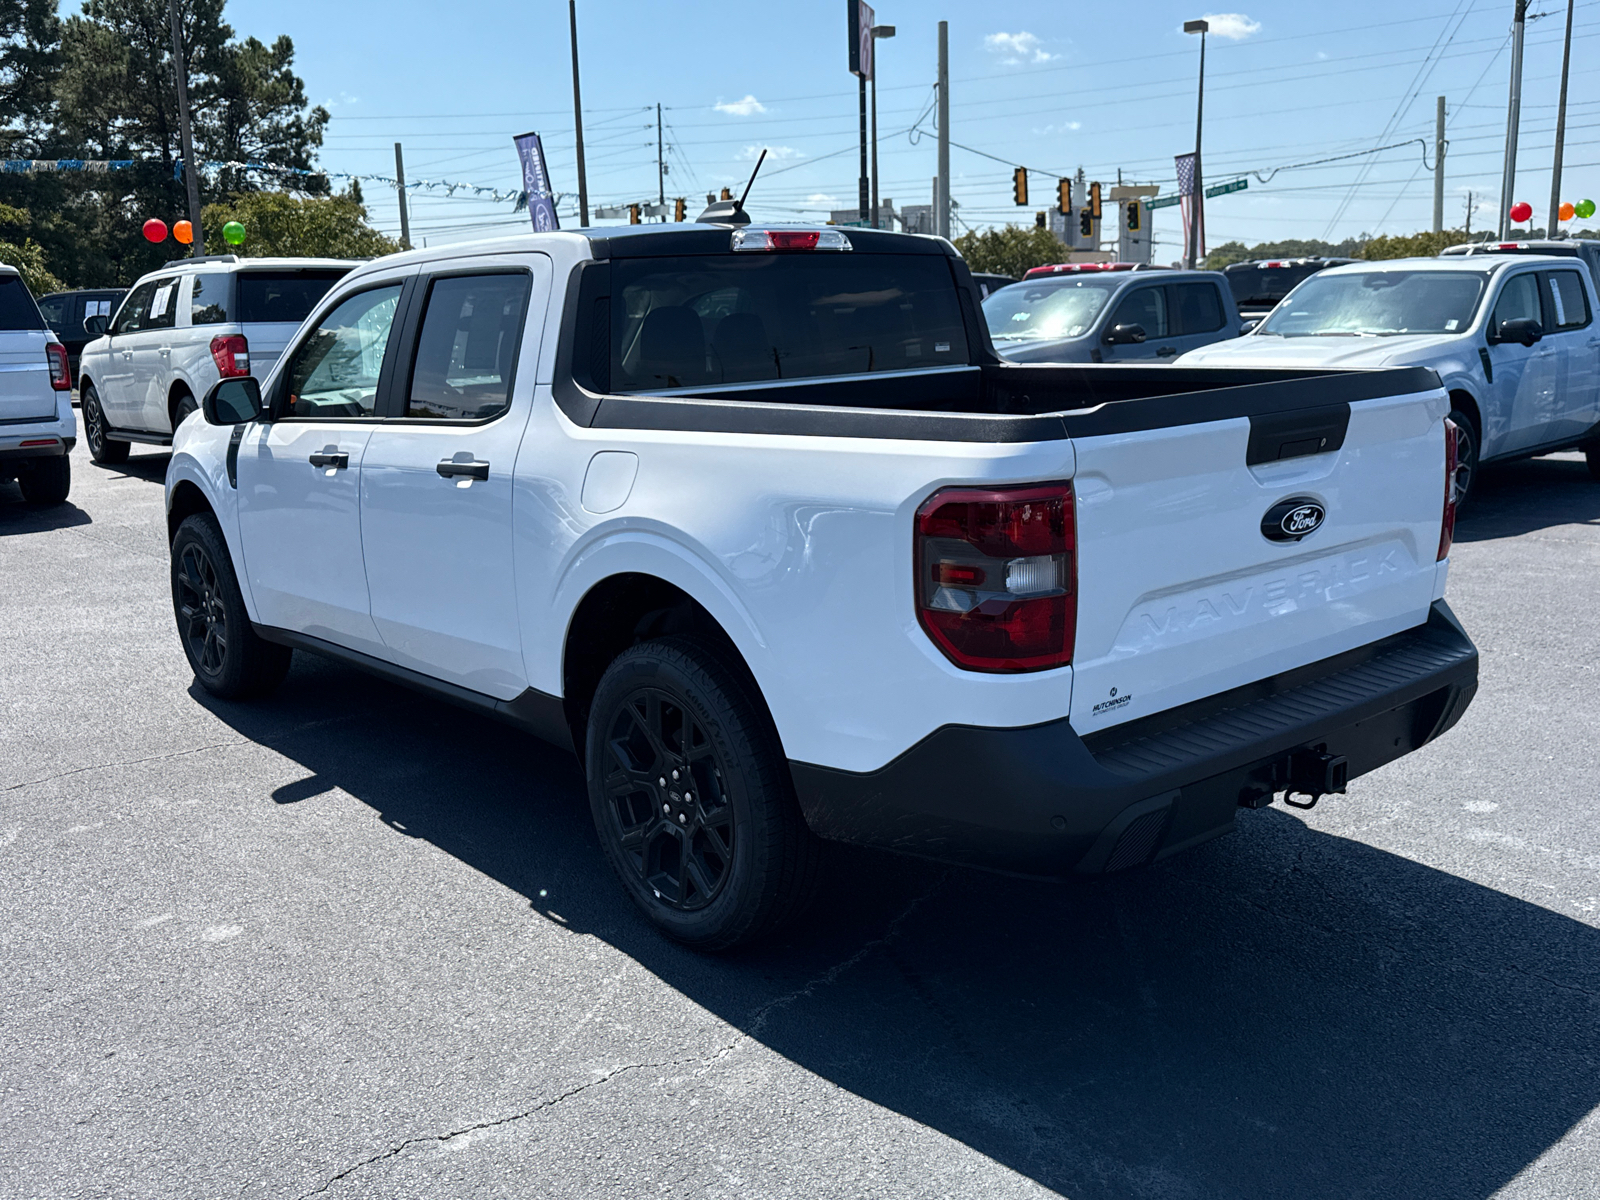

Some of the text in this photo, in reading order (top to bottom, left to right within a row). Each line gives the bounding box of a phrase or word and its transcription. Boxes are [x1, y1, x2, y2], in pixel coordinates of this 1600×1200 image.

[1290, 508, 1317, 531] Ford
[1141, 550, 1397, 639] MAVERICK
[1092, 694, 1132, 712] HUTCHINSON
